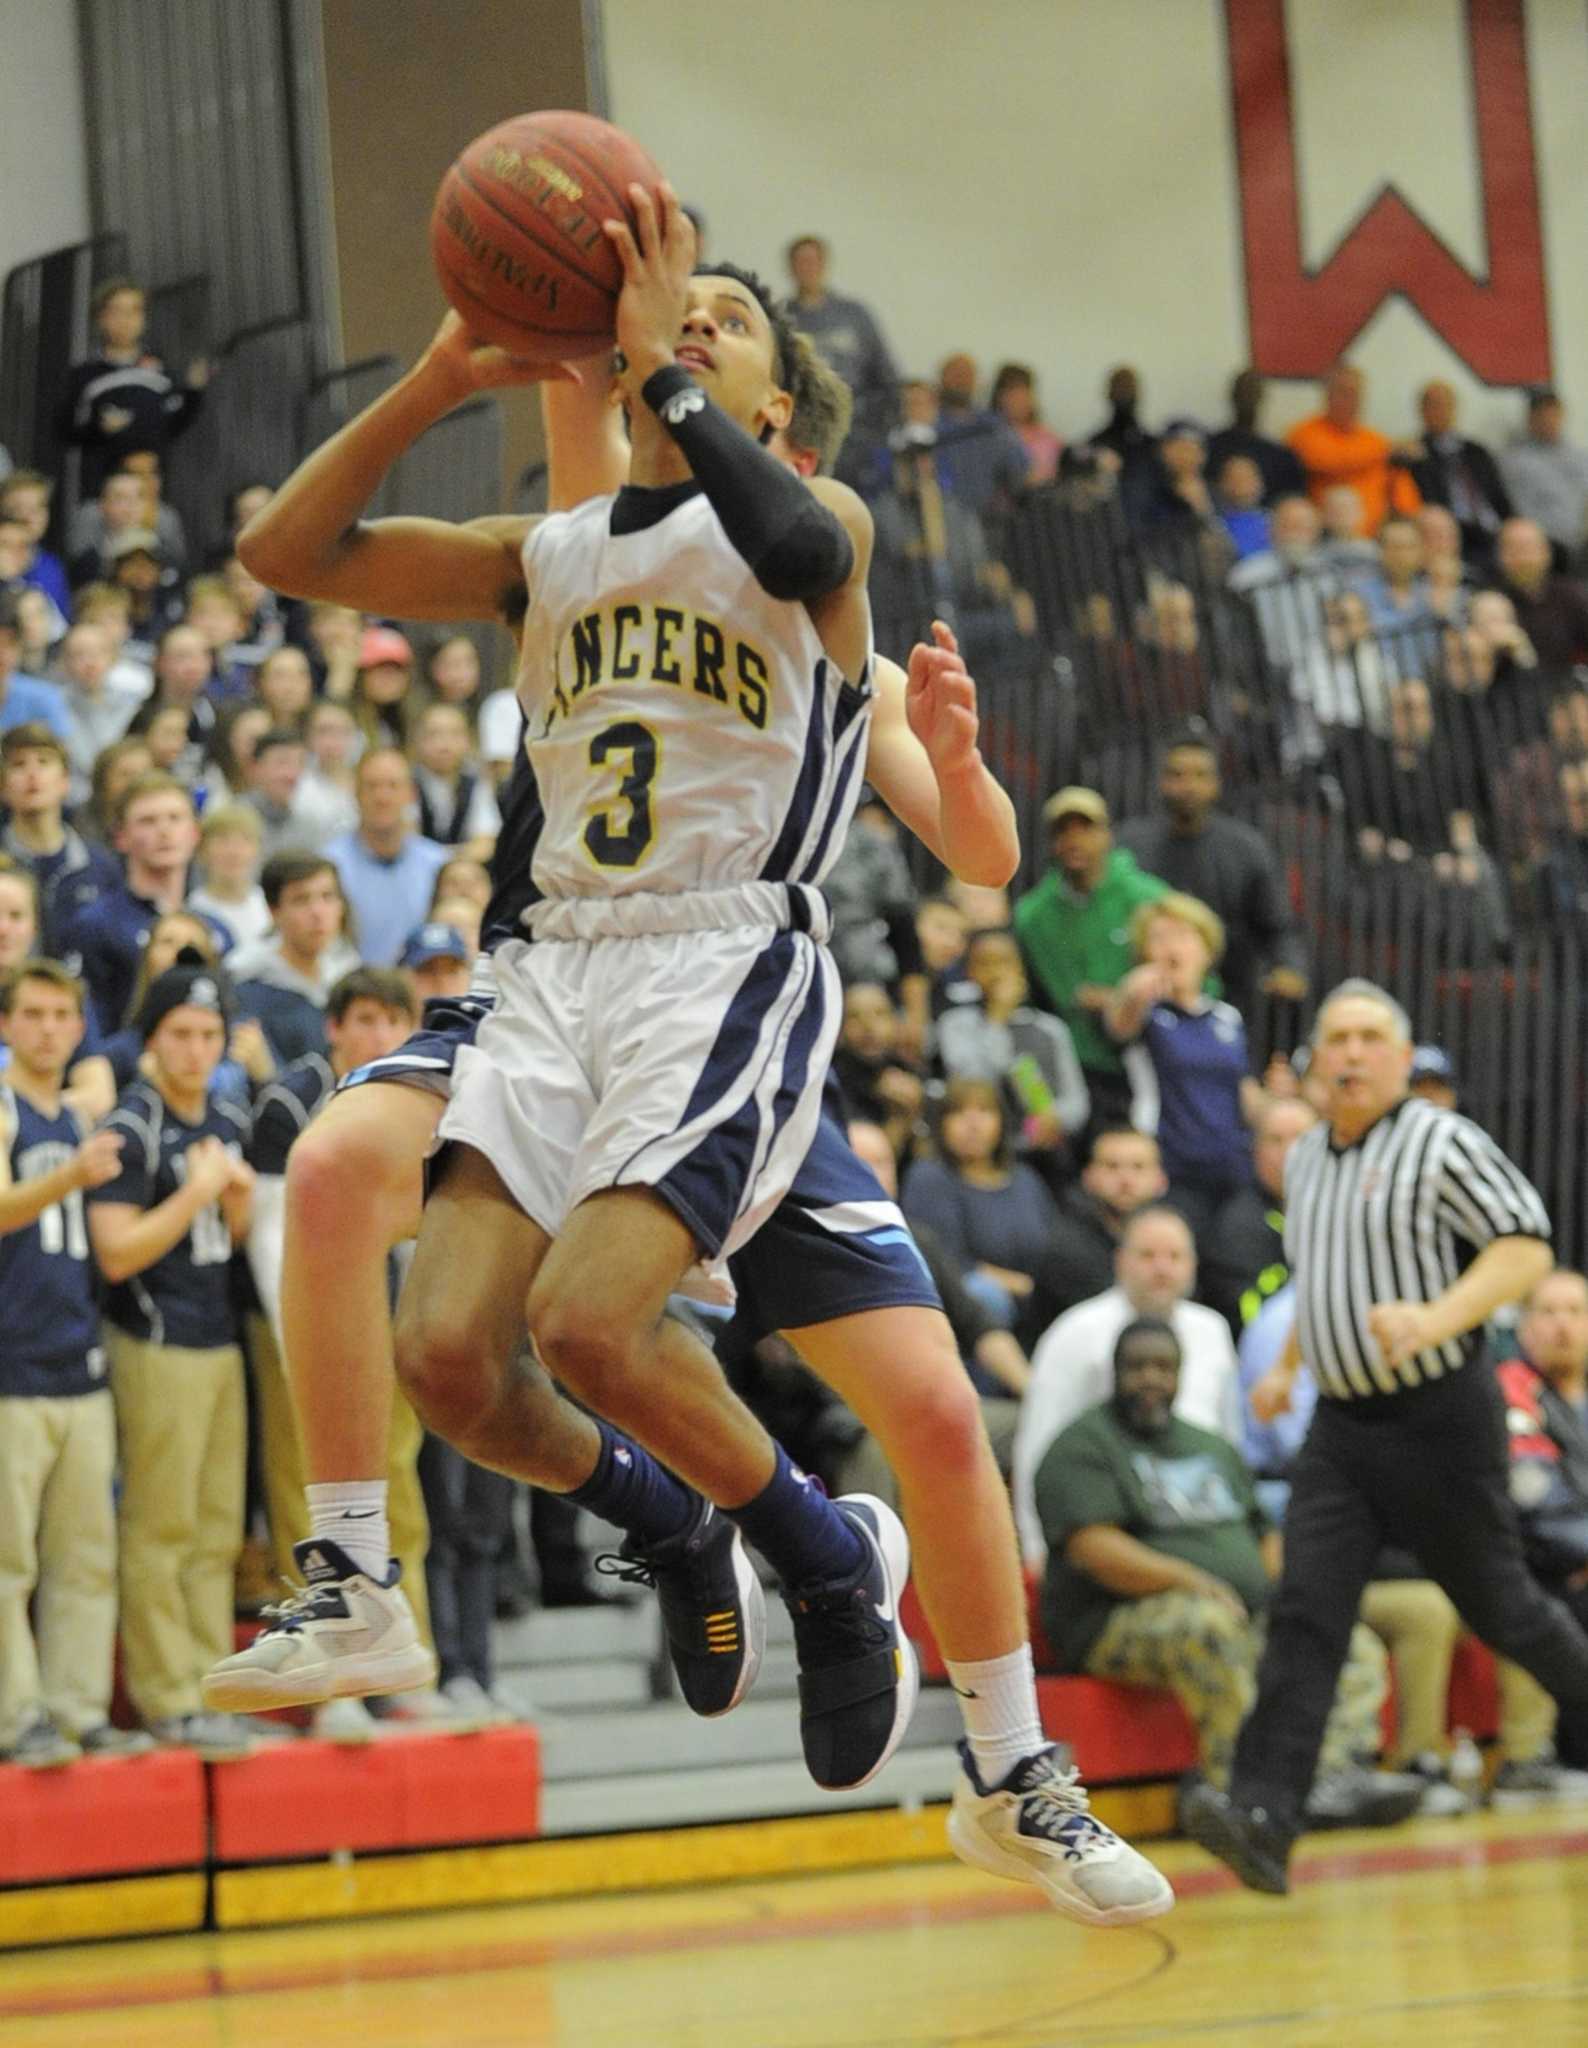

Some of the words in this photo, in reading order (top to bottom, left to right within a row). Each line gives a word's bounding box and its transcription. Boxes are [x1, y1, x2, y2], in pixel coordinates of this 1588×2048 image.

[1221, 0, 1554, 387] W
[545, 604, 769, 732] NCERS
[583, 718, 657, 868] 3
